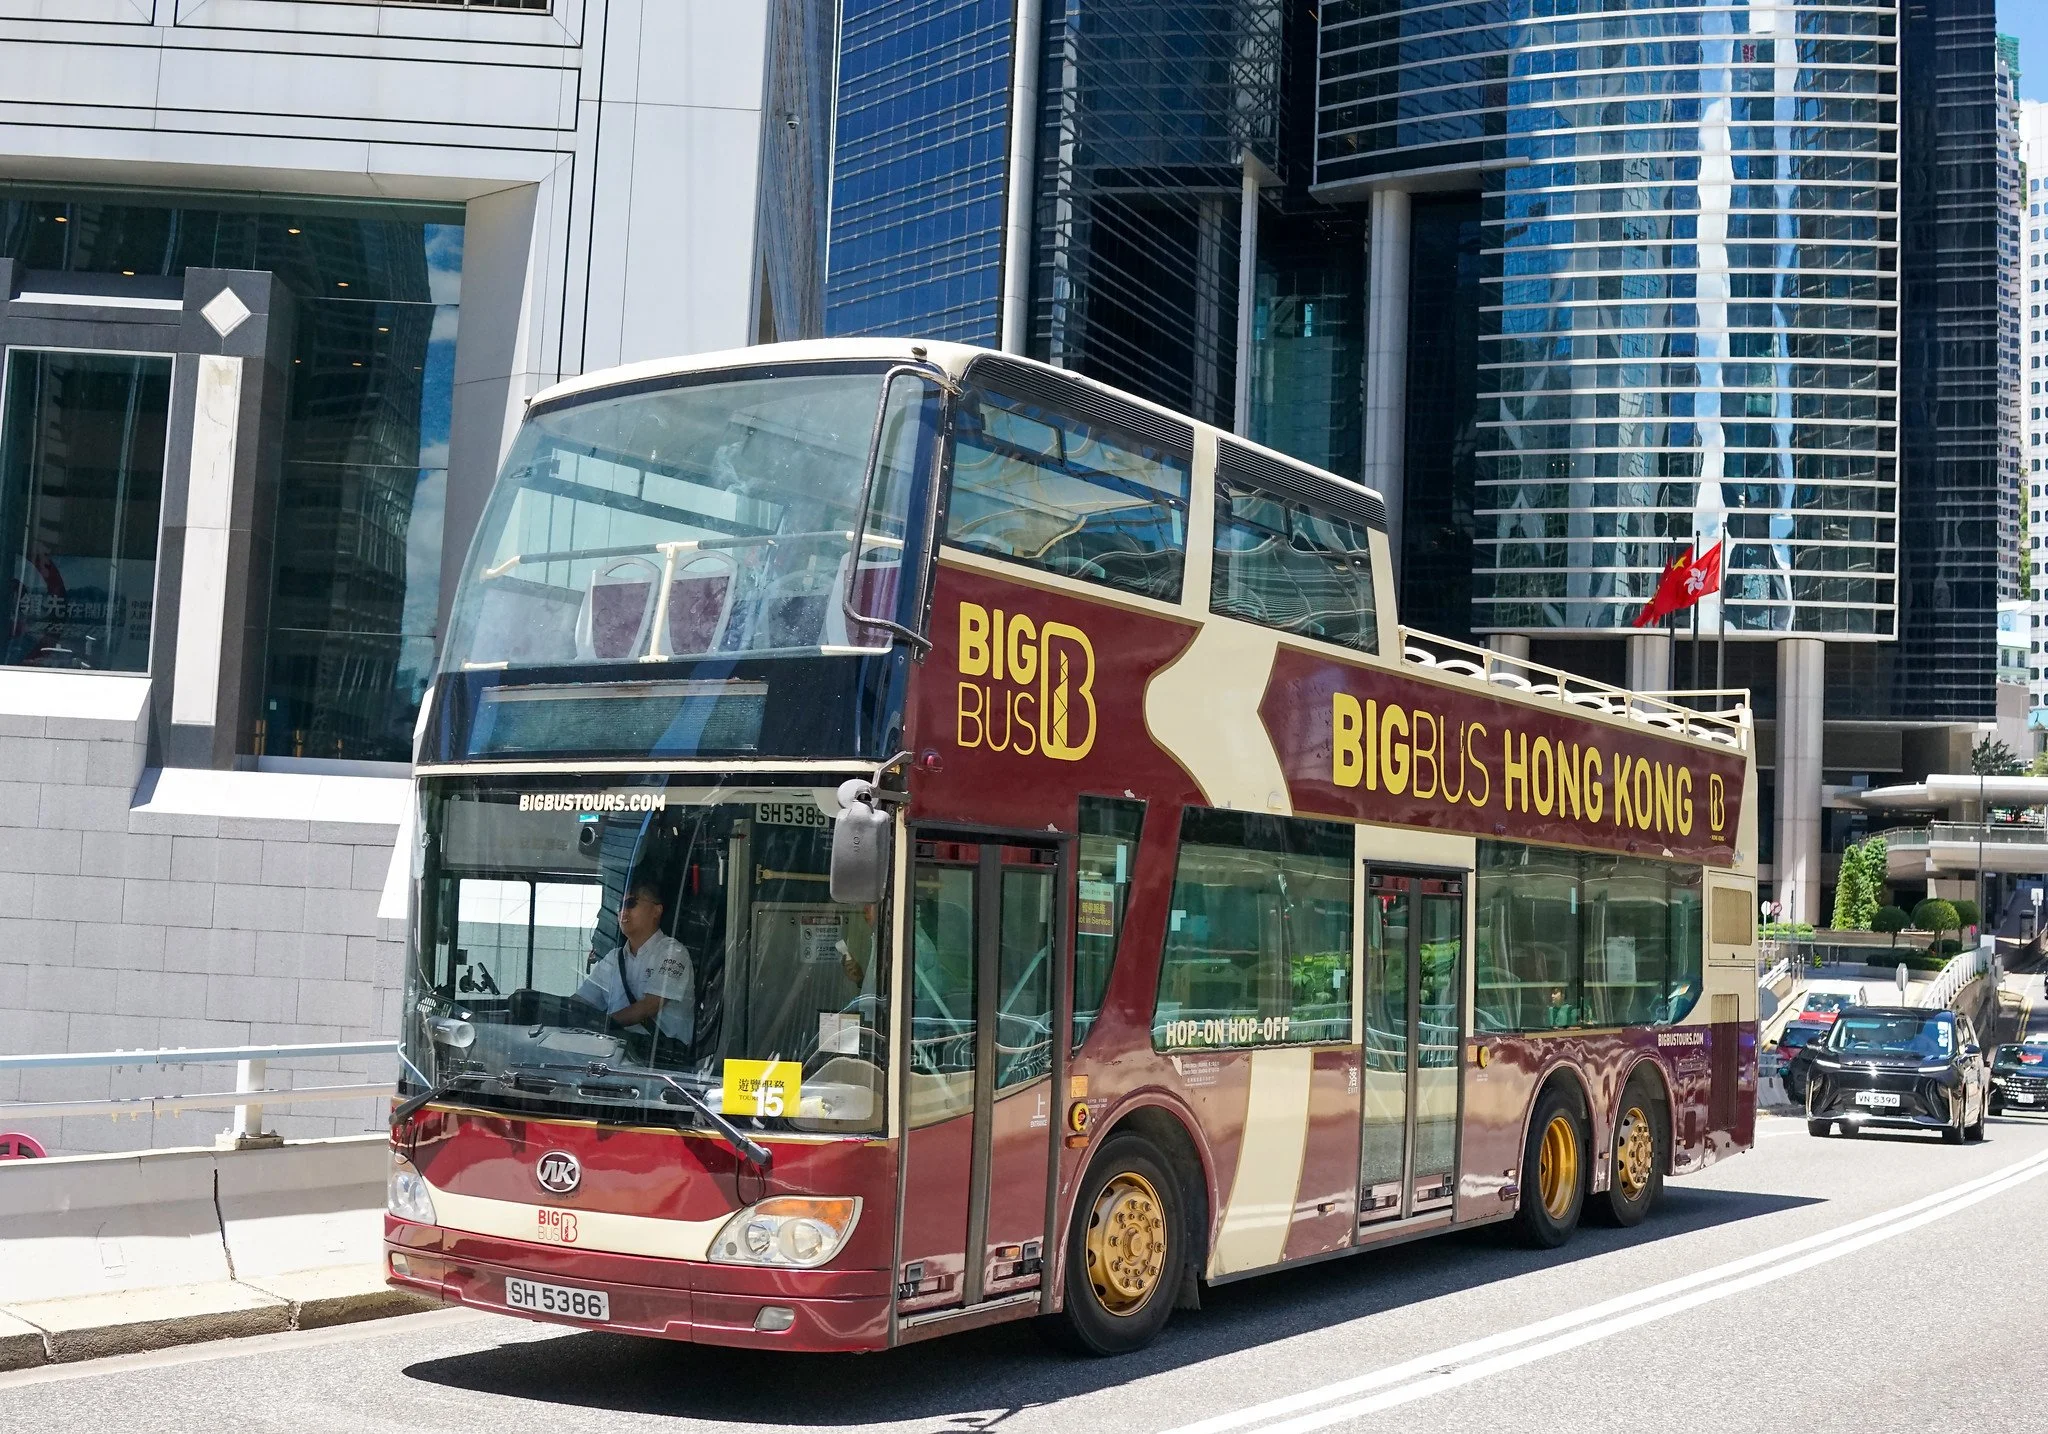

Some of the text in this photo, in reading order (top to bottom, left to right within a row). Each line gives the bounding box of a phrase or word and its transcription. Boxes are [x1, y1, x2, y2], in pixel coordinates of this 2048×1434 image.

[959, 601, 1038, 685] BIG
[957, 681, 1037, 756] BUS
[1504, 729, 1604, 823] HONG
[1613, 752, 1693, 837] KONG
[519, 794, 666, 811] BIGBUSTOURS.COM
[760, 803, 781, 823] SH
[1166, 1016, 1290, 1046] HOP-ON HOP-OFF
[1657, 1032, 1704, 1047] BIGBUSTOURS.COM
[752, 1086, 784, 1117] 15
[1032, 1093, 1046, 1119] 上
[1859, 1095, 1898, 1105] VN 5390
[538, 1209, 560, 1227] BIG
[538, 1225, 560, 1242] BUS
[511, 1281, 602, 1318] SH 5386
